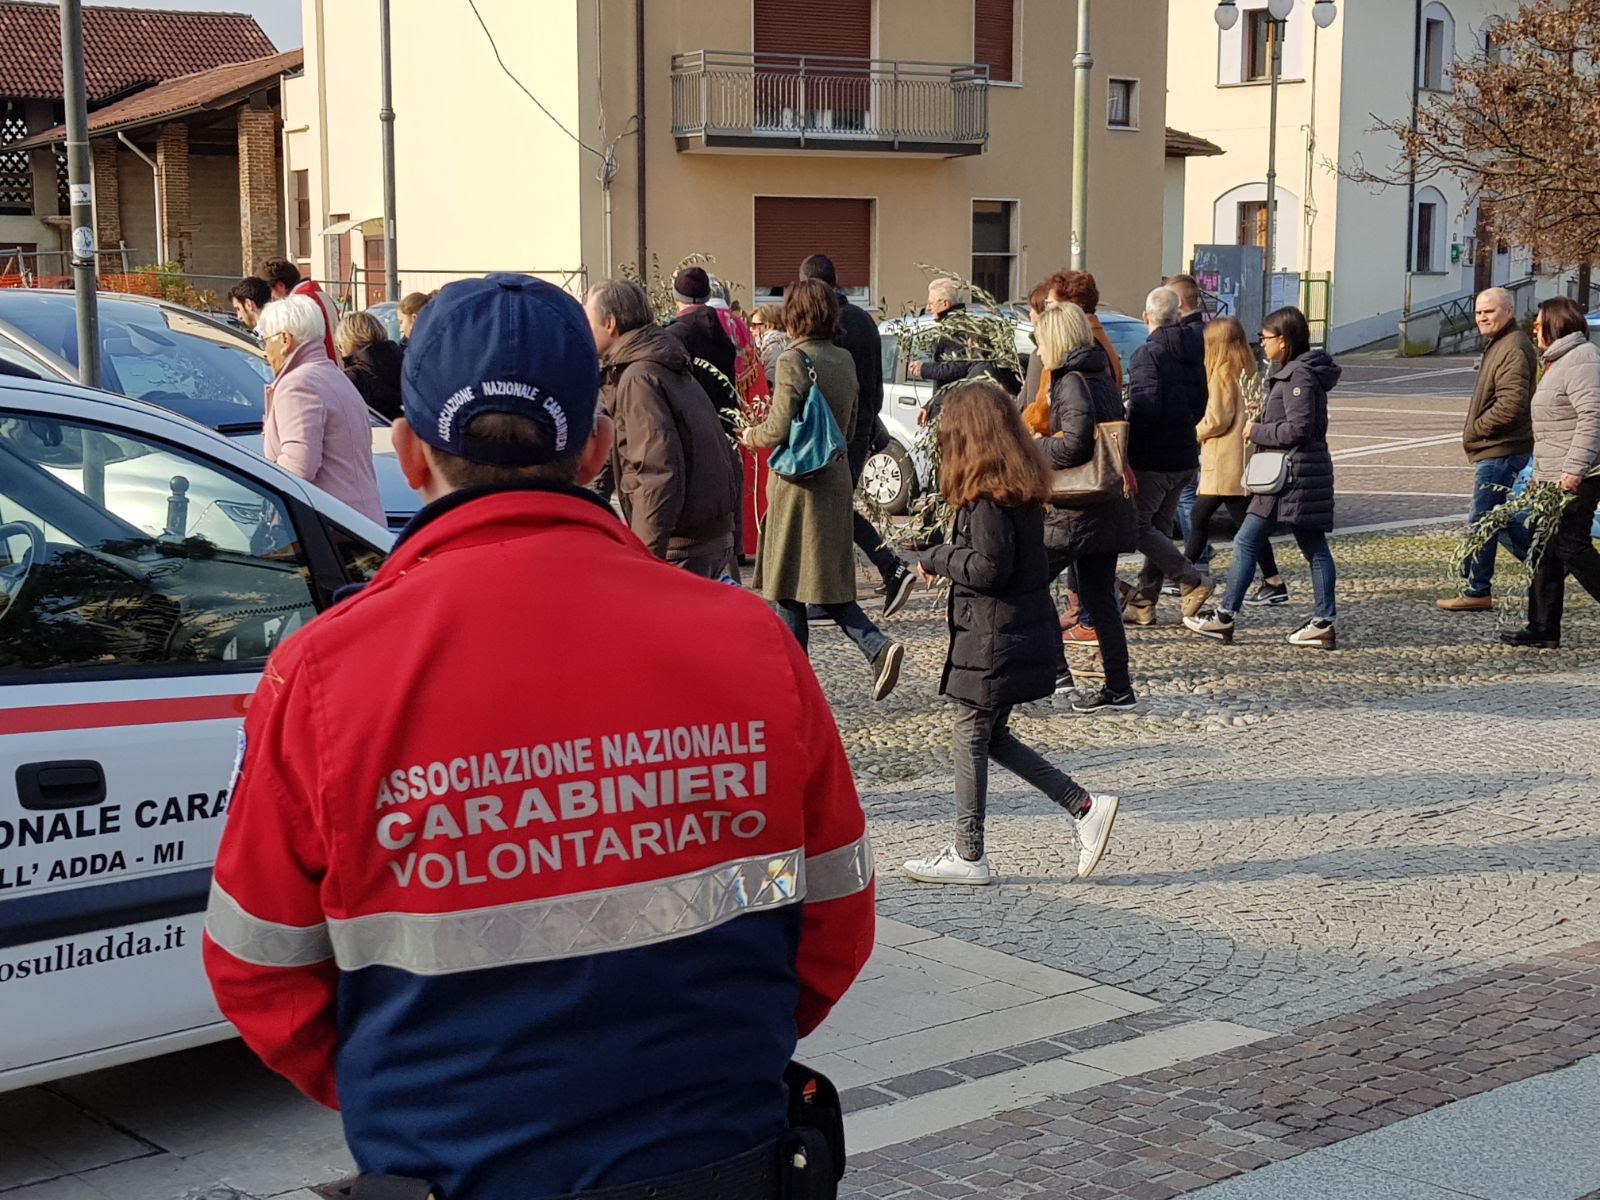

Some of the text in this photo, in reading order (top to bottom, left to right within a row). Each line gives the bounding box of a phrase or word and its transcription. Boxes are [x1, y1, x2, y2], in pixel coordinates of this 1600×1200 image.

[437, 381, 569, 452] ASSOCIAZIONE NAZIONALE CARABINIERI
[375, 720, 767, 810] ASSOCIAZIONE NAZIONALE
[376, 760, 768, 851] CARABINIERI
[153, 840, 184, 865] MI
[387, 810, 767, 890] VOLONTARIATO
[0, 924, 187, 983] osulladda.it
